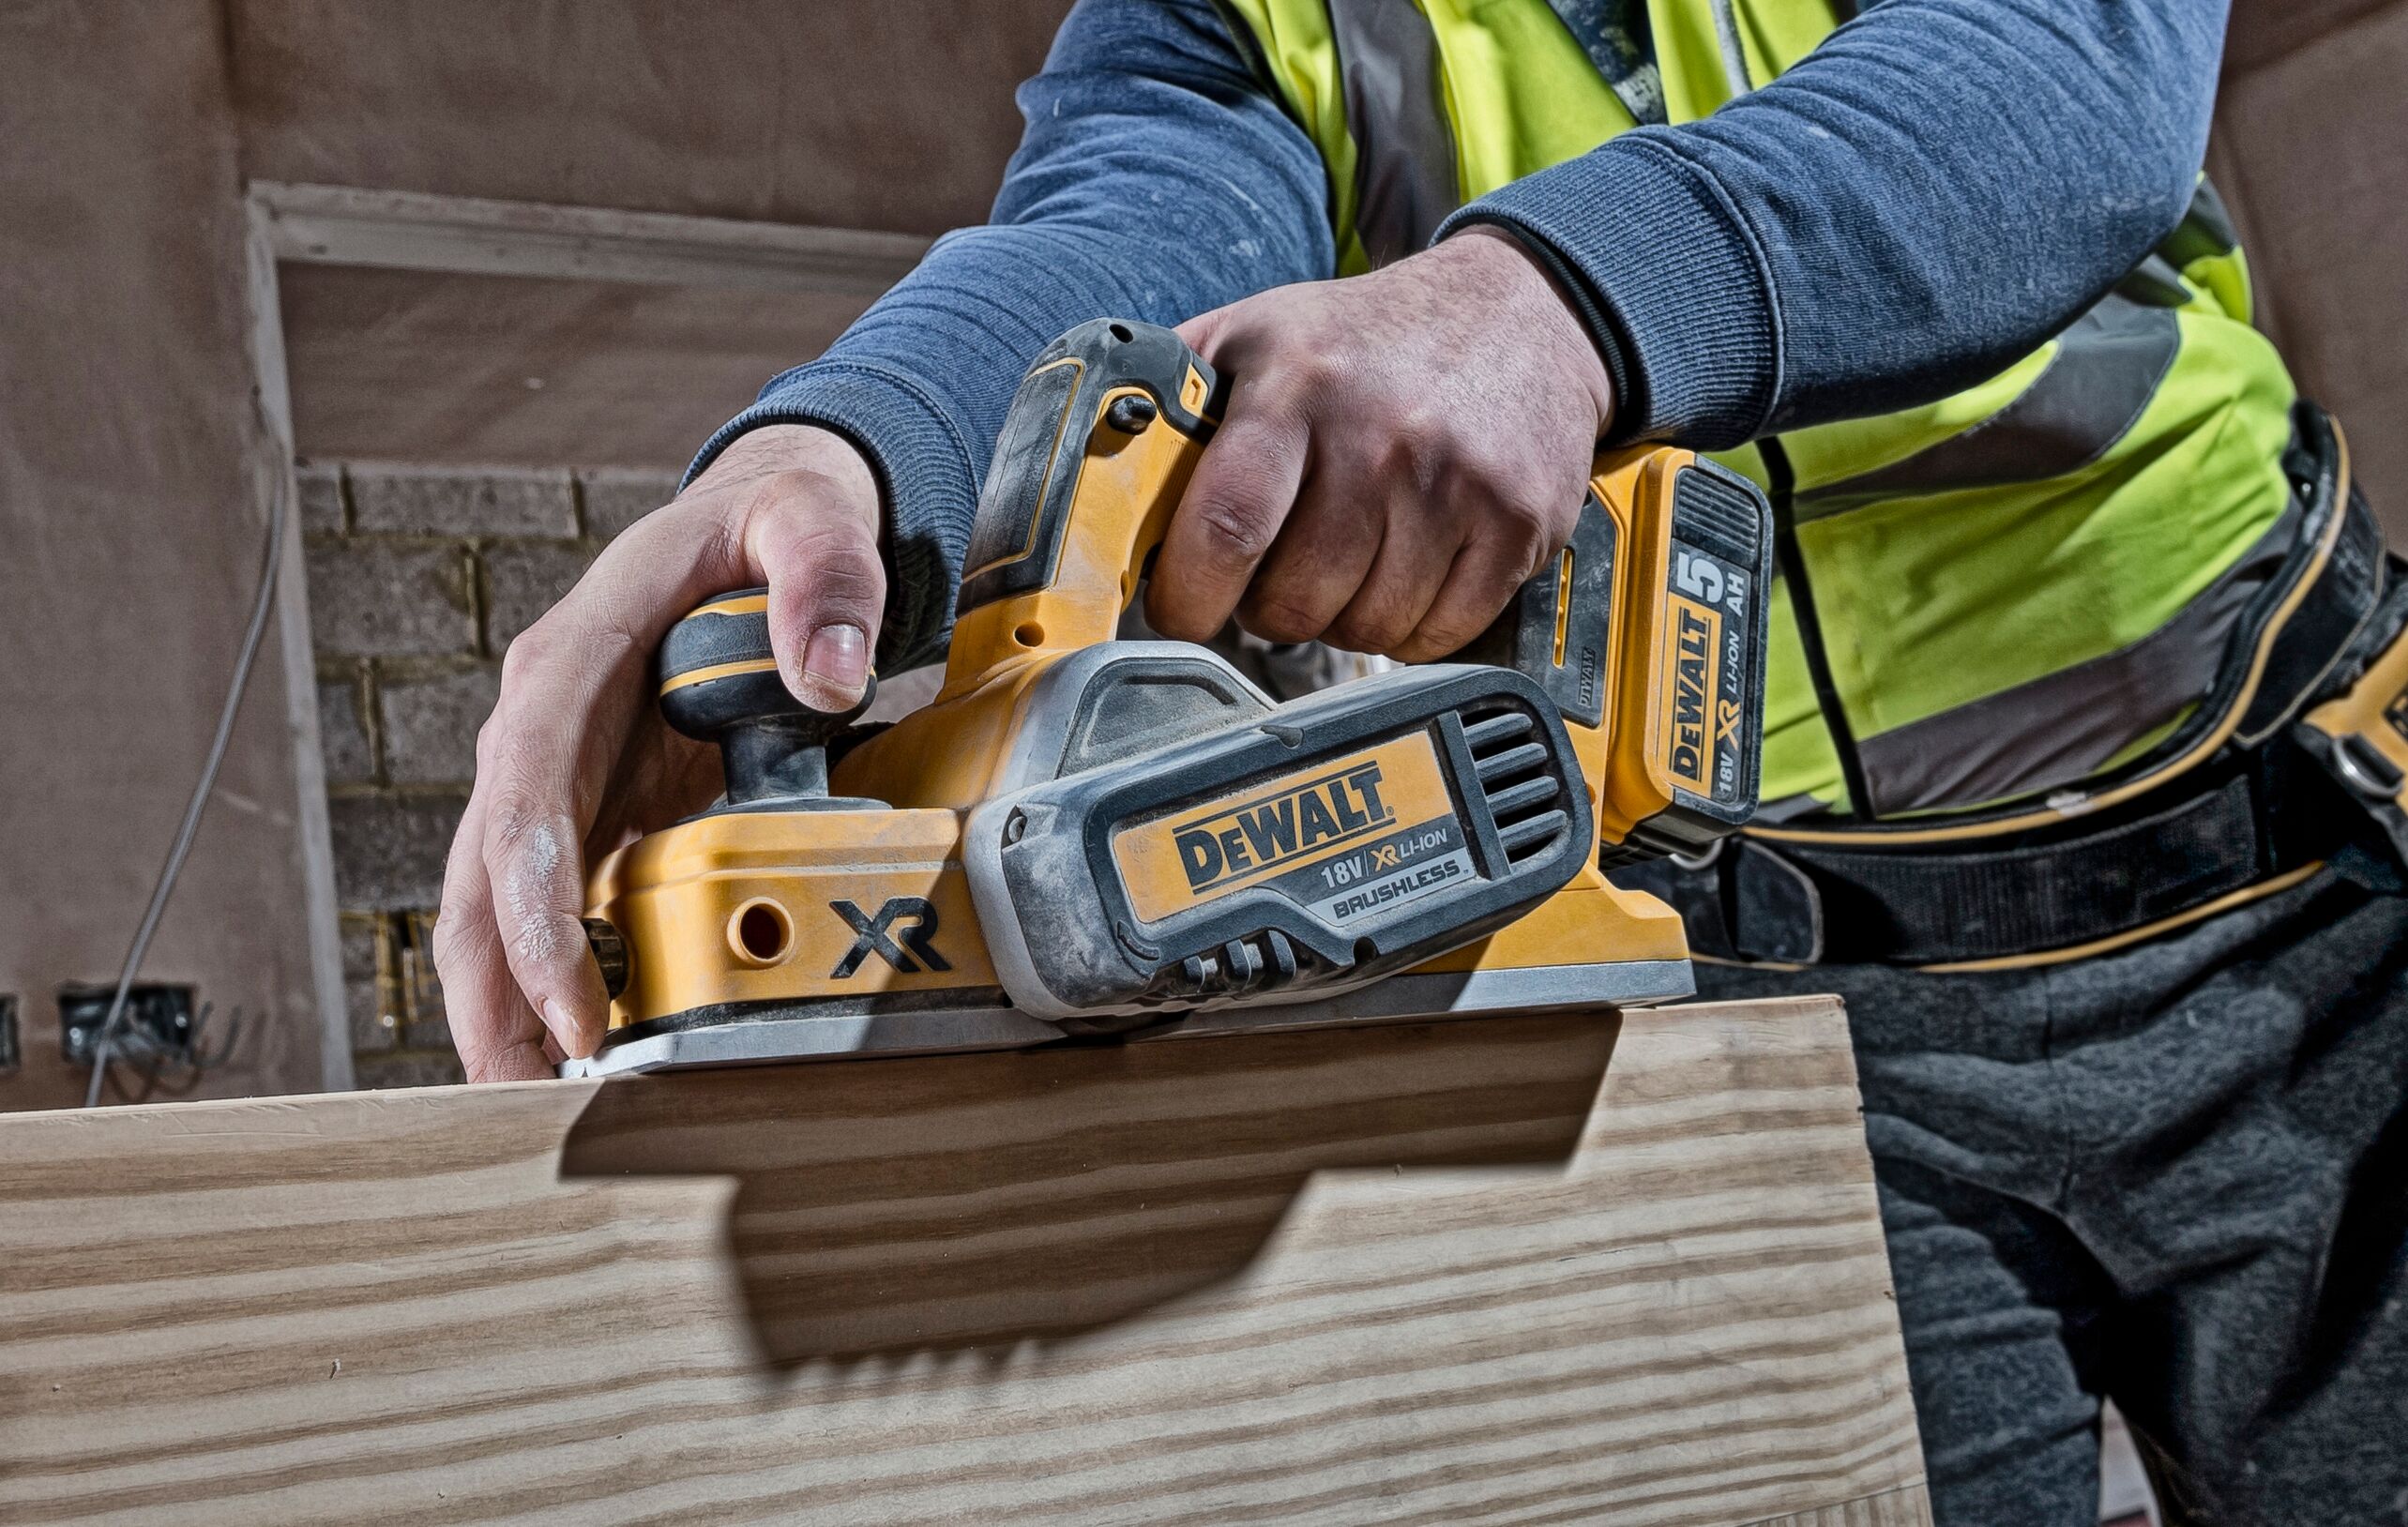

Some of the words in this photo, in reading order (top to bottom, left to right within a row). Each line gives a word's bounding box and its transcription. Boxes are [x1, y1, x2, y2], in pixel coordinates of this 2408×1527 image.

[1677, 551, 1724, 603] 5
[1727, 632, 1740, 695] LI-ION
[1716, 701, 1740, 749] XR
[1719, 753, 1736, 794] 18V
[1371, 844, 1401, 871] XR
[1400, 828, 1447, 858] LI-ION
[1333, 859, 1461, 919] BRUSHLESS
[829, 897, 952, 979] XR
